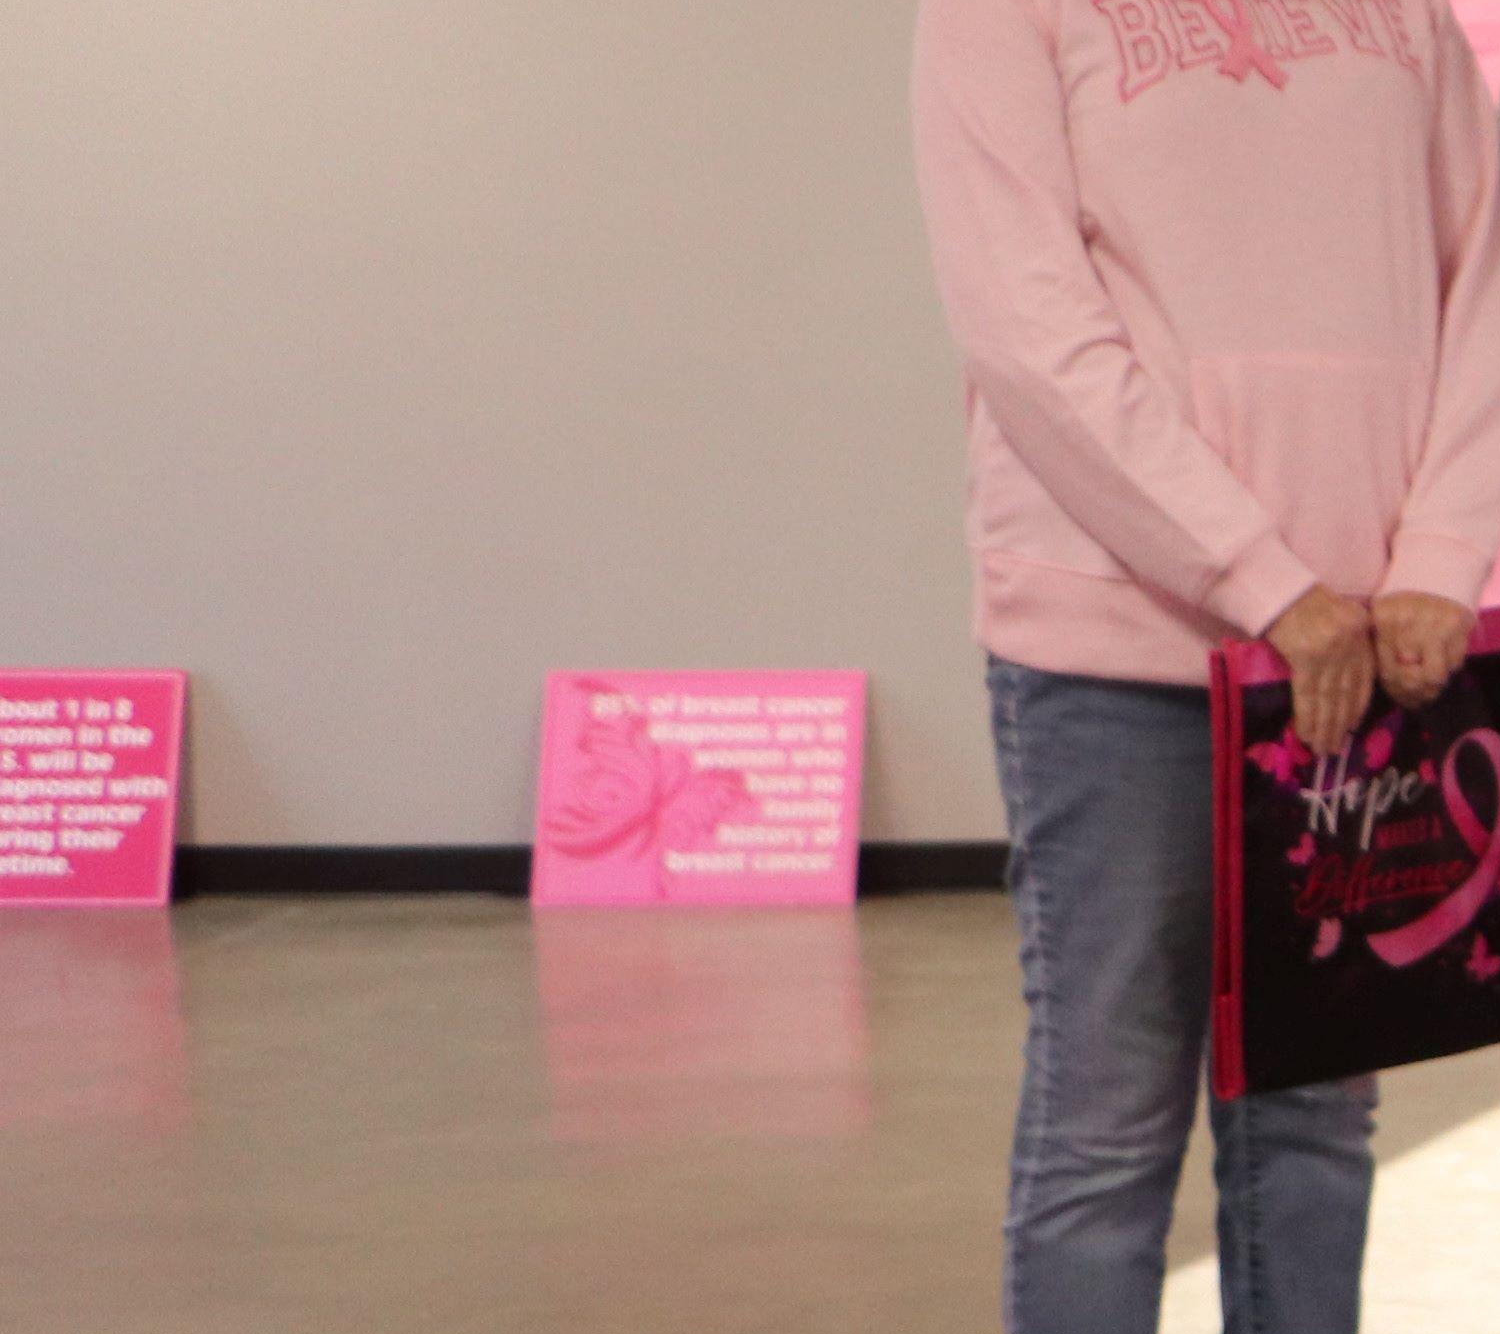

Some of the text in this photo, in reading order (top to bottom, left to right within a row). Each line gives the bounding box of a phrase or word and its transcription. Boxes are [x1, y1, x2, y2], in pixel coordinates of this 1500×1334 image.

[84, 698, 111, 720] in
[77, 724, 103, 746] in
[107, 724, 154, 748] the
[28, 750, 77, 772] will
[81, 750, 115, 772] be
[108, 776, 169, 798] with
[1298, 731, 1428, 852] Hope
[0, 804, 147, 824] east cancer
[58, 829, 125, 851] their
